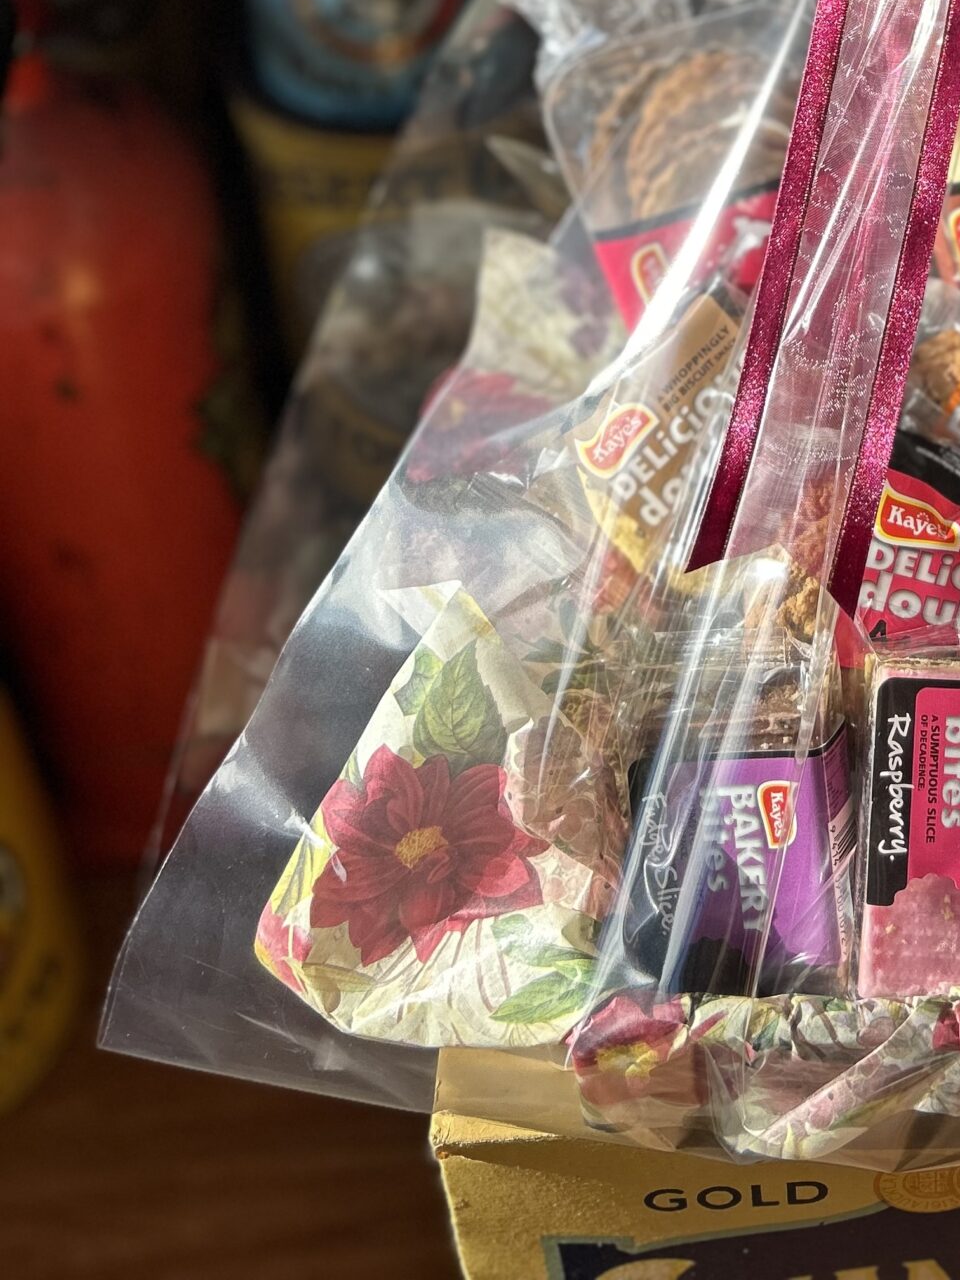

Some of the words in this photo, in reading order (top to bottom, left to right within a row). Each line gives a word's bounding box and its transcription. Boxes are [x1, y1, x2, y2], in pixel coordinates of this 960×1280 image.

[663, 325, 730, 398] WHOPPINGLY
[664, 394, 680, 413] BIG
[679, 359, 715, 398] BISCUIT
[920, 714, 928, 729] OF
[931, 715, 938, 723] A
[877, 712, 915, 862] Raspberry.
[918, 730, 927, 791] DECADENCE.
[927, 725, 940, 805] SUMPTUOUS
[769, 791, 786, 839] Kaye's
[925, 808, 935, 844] SLICE
[730, 783, 768, 932] BAKERY
[643, 1181, 829, 1212] GOLD
